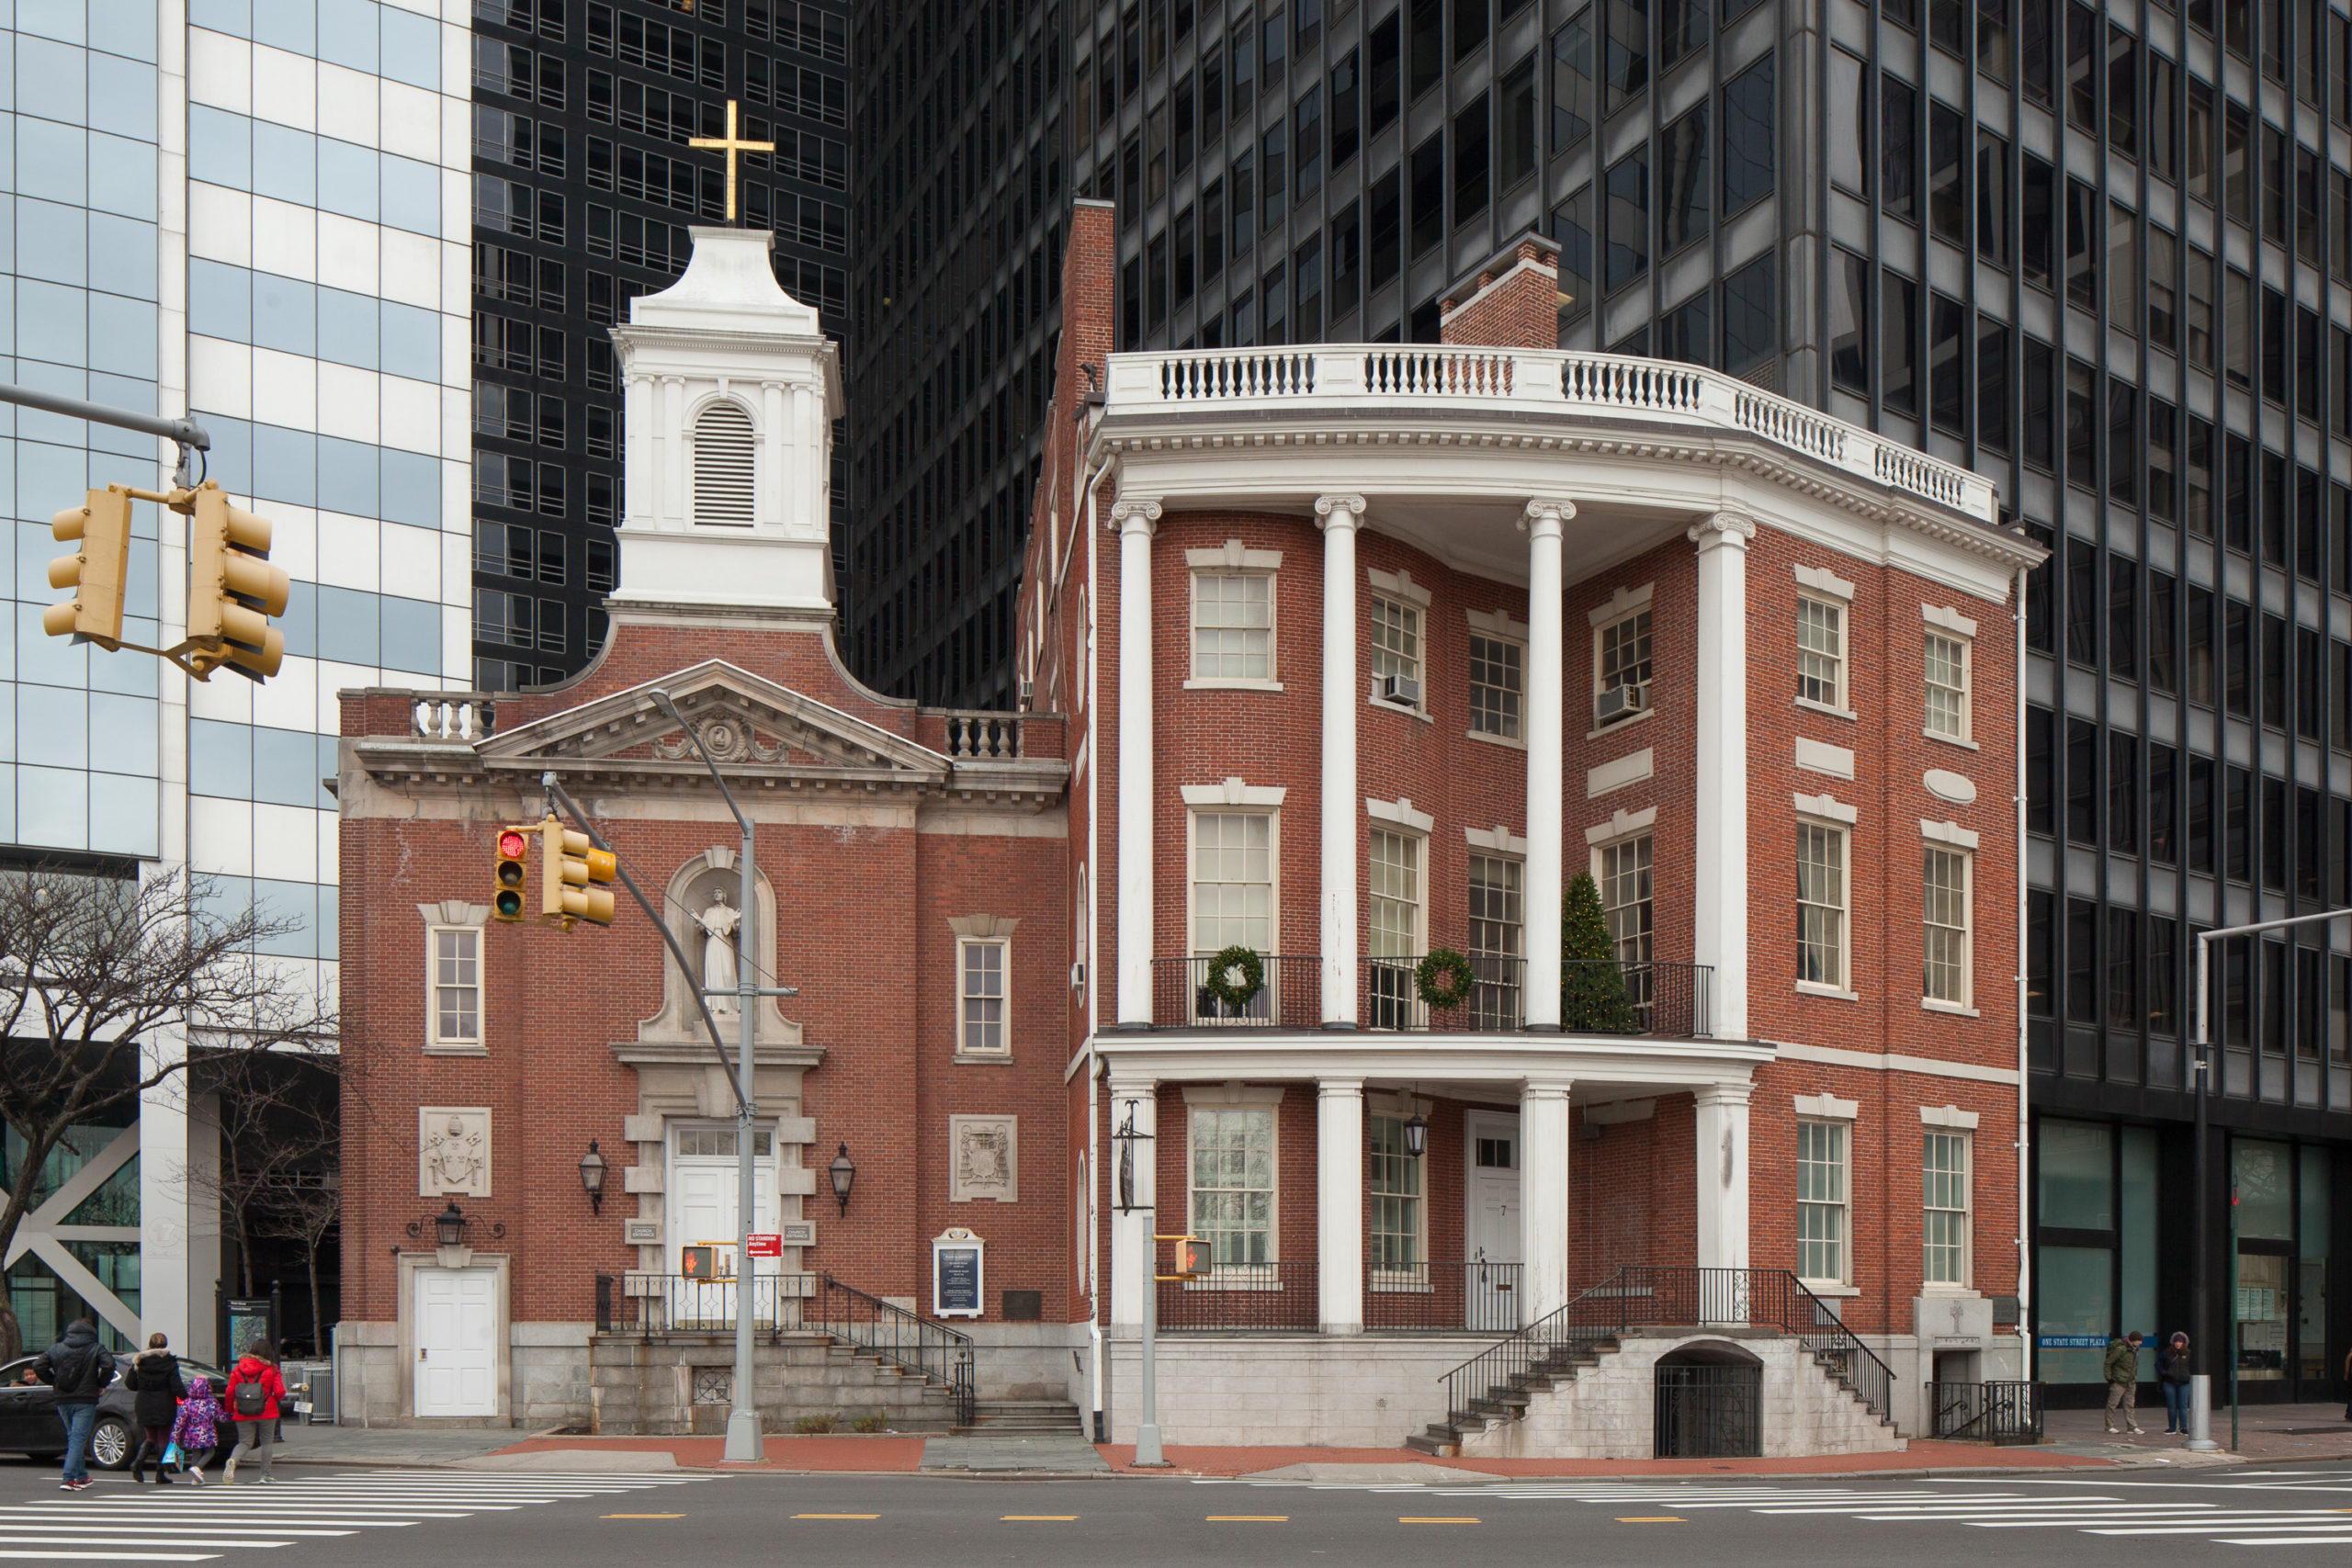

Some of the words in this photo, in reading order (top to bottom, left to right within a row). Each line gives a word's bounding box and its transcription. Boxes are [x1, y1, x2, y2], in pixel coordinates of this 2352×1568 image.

[1500, 1204, 1507, 1216] 7
[2041, 1337, 2052, 1346] ONE
[2052, 1337, 2069, 1346] STATE
[2069, 1337, 2088, 1346] STREET
[2089, 1337, 2106, 1346] PLAZA
